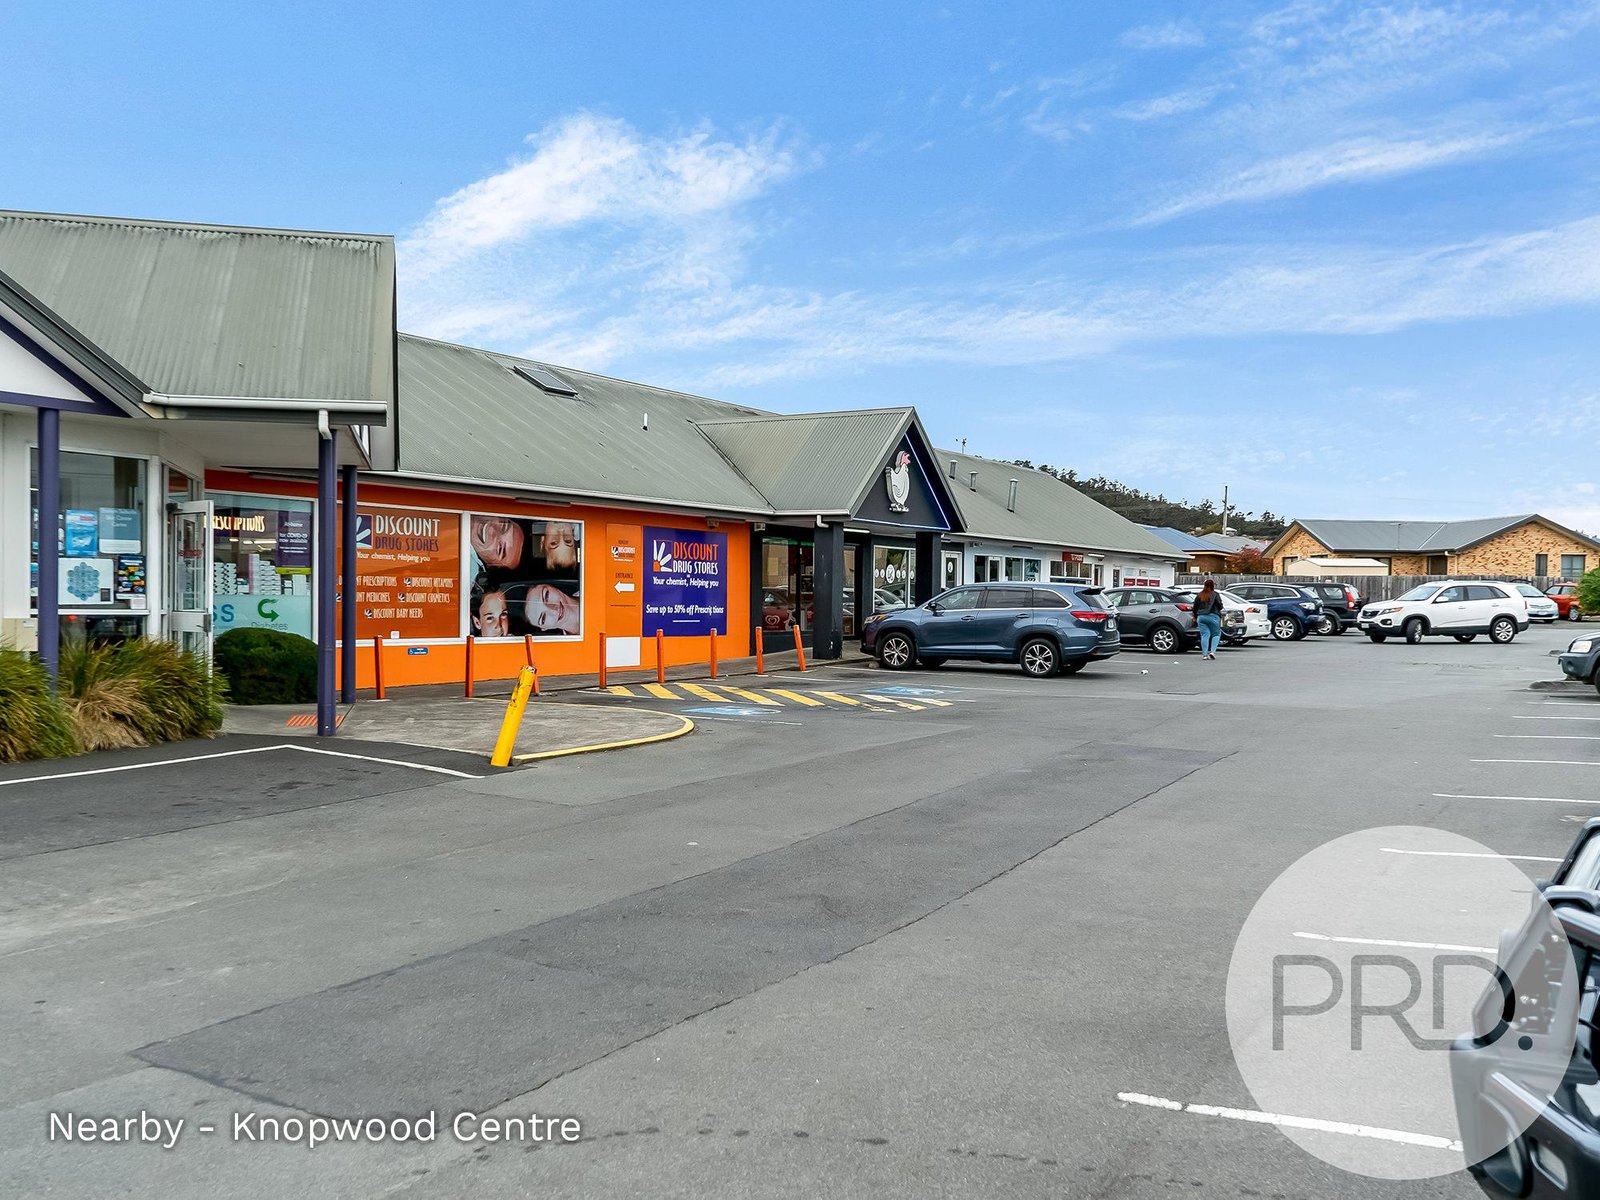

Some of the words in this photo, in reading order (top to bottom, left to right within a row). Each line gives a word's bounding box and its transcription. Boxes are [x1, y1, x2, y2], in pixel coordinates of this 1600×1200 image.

[375, 514, 440, 537] DISCOUNT
[375, 536, 402, 550] DRUG
[405, 537, 439, 552] STORES
[673, 541, 719, 561] DISCOUNT
[397, 554, 420, 563] Helping
[420, 555, 431, 563] you
[673, 560, 693, 574] DRUG
[694, 561, 719, 575] STORES
[653, 576, 665, 585] Your
[666, 576, 689, 587] chemist,
[690, 577, 709, 589] Helping
[646, 604, 659, 613] Save
[659, 606, 667, 616] up
[674, 604, 686, 613] 50%
[686, 605, 694, 615] off
